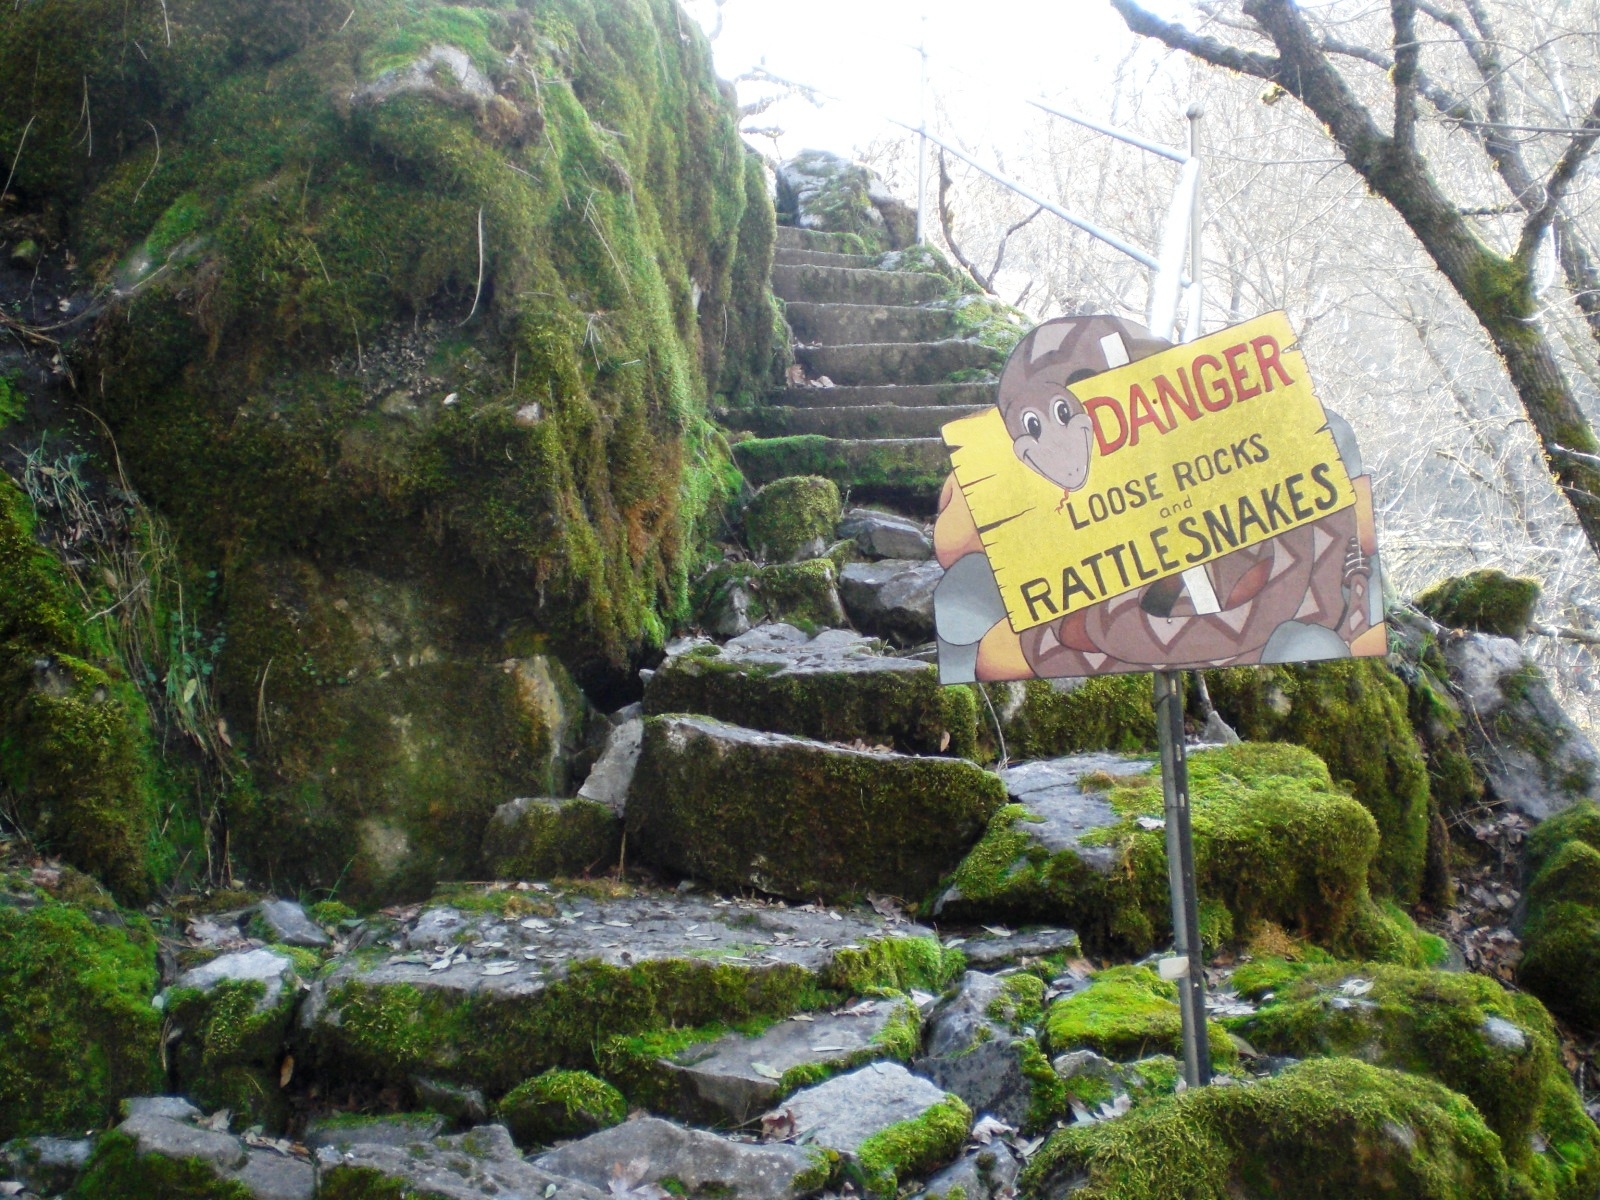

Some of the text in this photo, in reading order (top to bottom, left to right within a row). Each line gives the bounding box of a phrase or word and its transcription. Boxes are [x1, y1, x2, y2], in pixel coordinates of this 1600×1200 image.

[1083, 334, 1295, 457] DANGER
[1067, 432, 1270, 531] LOOSE ROCKS
[1159, 498, 1193, 519] and
[1019, 462, 1339, 622] RATTLESNAKES
